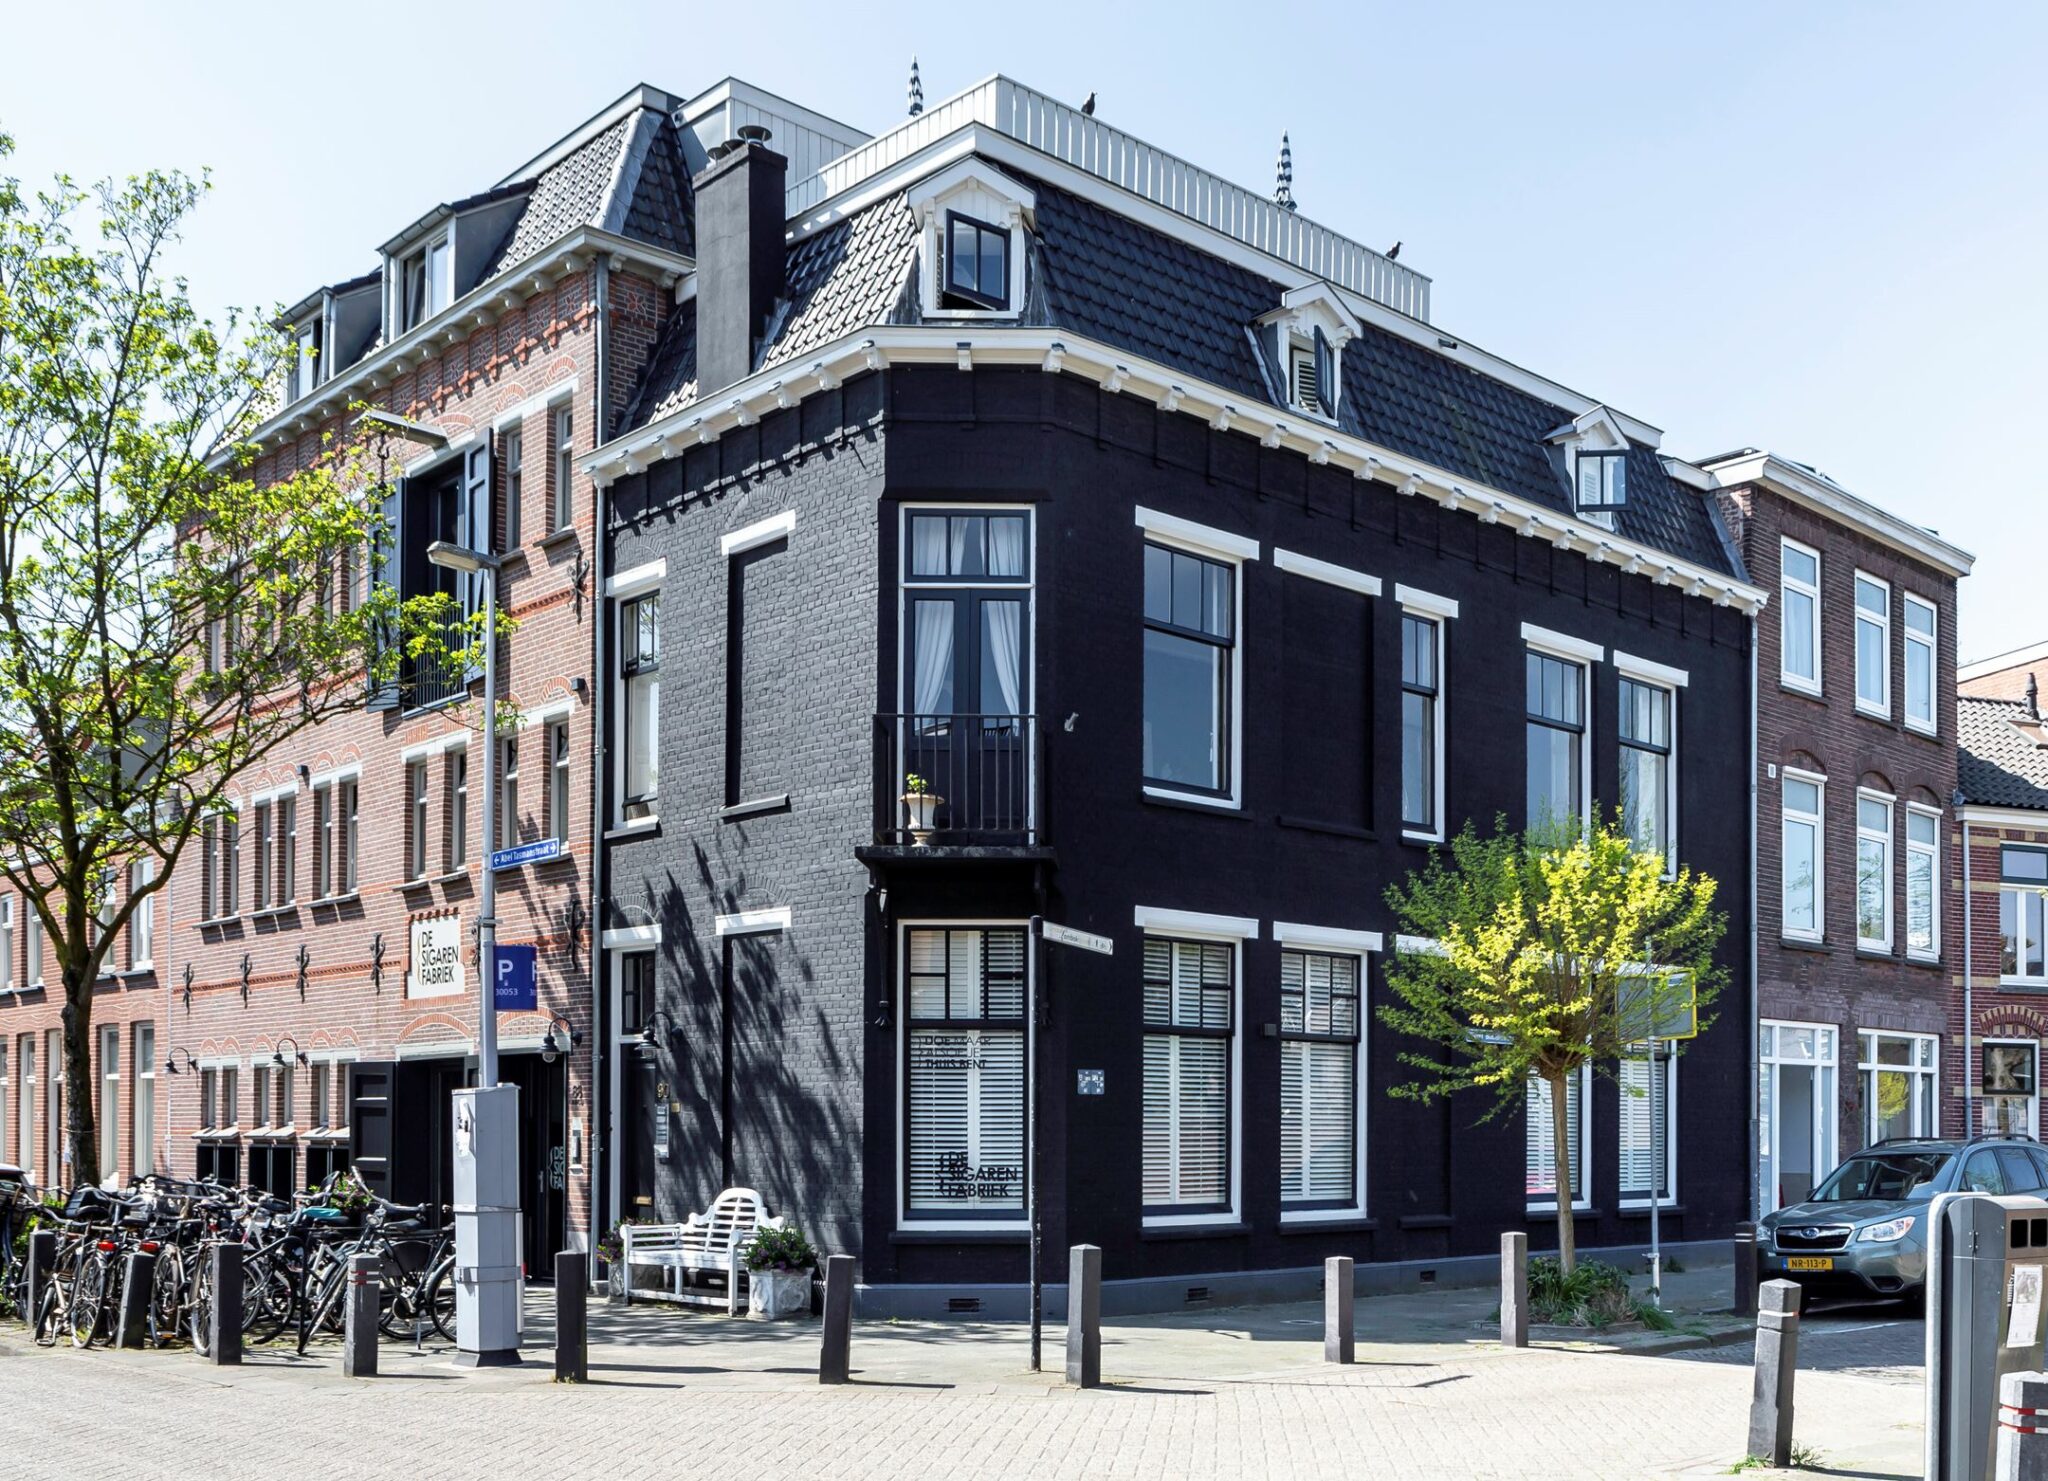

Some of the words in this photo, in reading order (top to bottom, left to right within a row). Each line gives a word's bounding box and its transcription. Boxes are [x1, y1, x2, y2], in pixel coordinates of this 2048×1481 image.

[500, 852, 513, 863] Abel
[513, 845, 550, 860] Tasmanstraat
[421, 930, 433, 948] DE
[421, 945, 459, 967] SIGAREN
[421, 966, 455, 986] FABRIEK
[498, 959, 514, 982] P
[948, 1167, 1018, 1182] SIGAREN
[948, 1183, 1009, 1198] FABRIEK
[1791, 1259, 1827, 1268] NR-113-P
